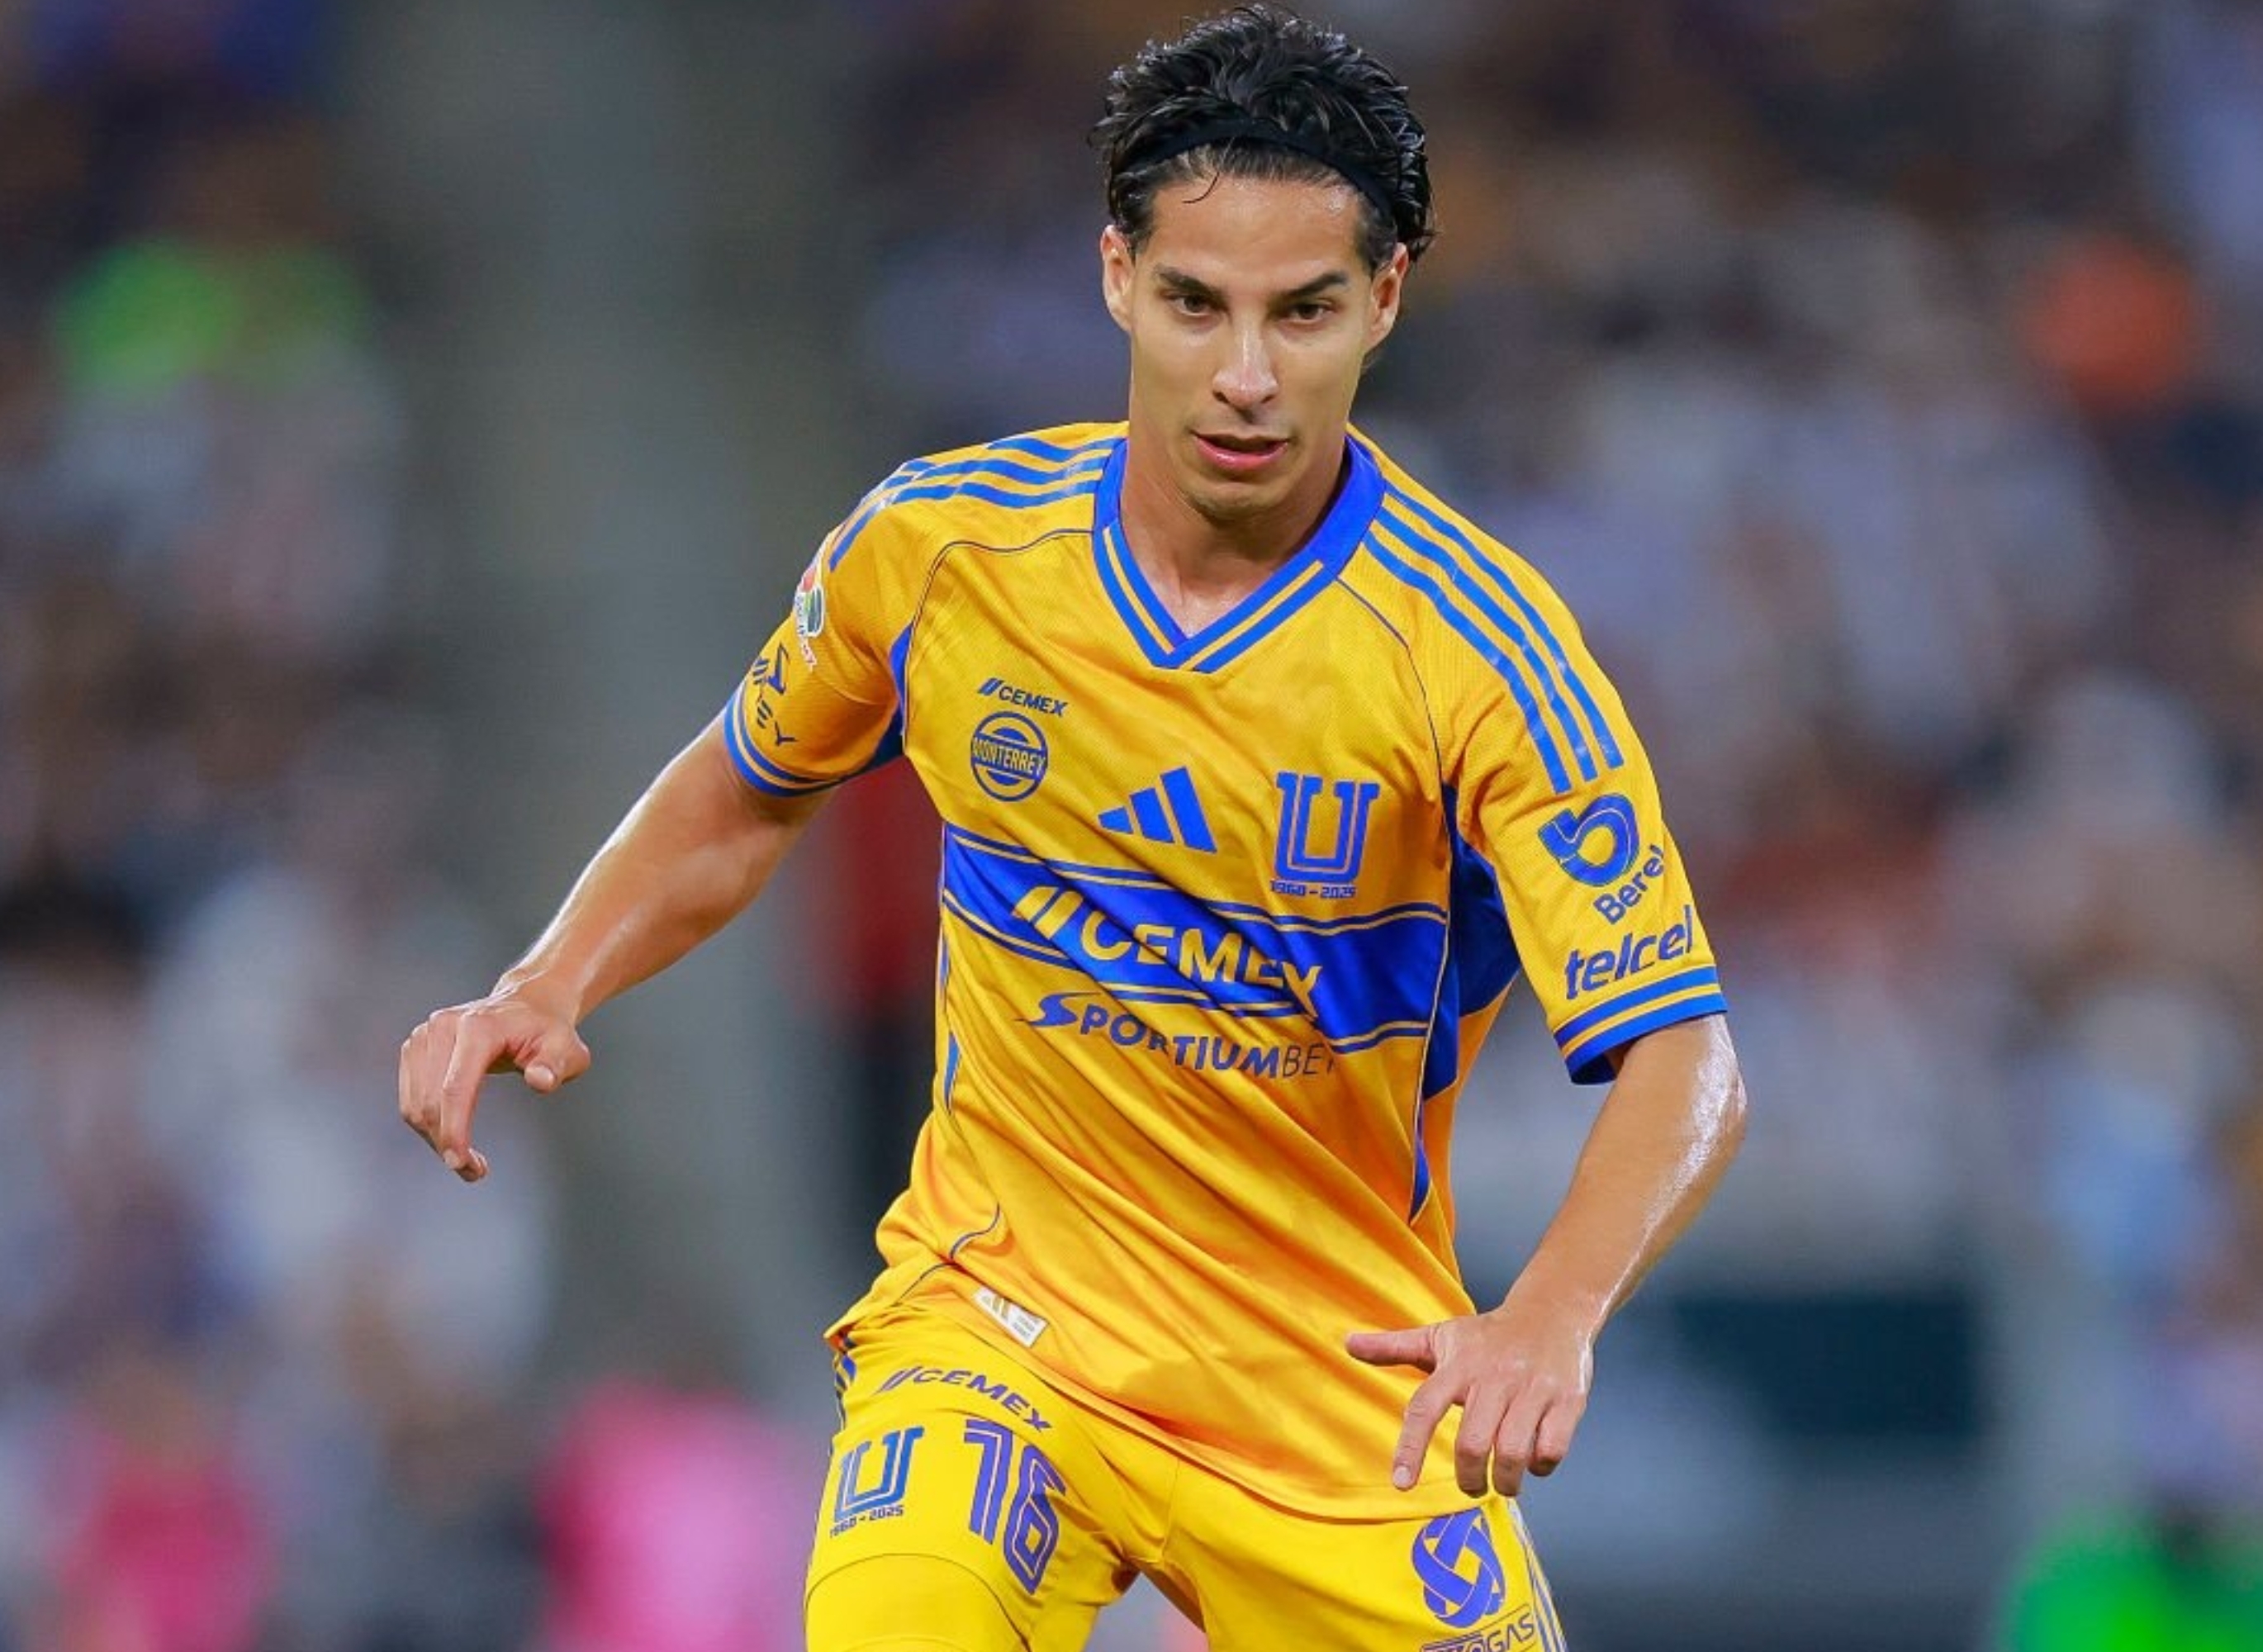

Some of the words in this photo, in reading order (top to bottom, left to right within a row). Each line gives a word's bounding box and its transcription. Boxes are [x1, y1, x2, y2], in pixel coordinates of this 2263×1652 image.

[998, 686, 1068, 717] CEMEX
[1563, 904, 1693, 1000] telcel
[1014, 991, 1339, 1080] SPORTIUMBE
[913, 1368, 1053, 1432] CEMEX
[963, 1418, 1068, 1596] 16
